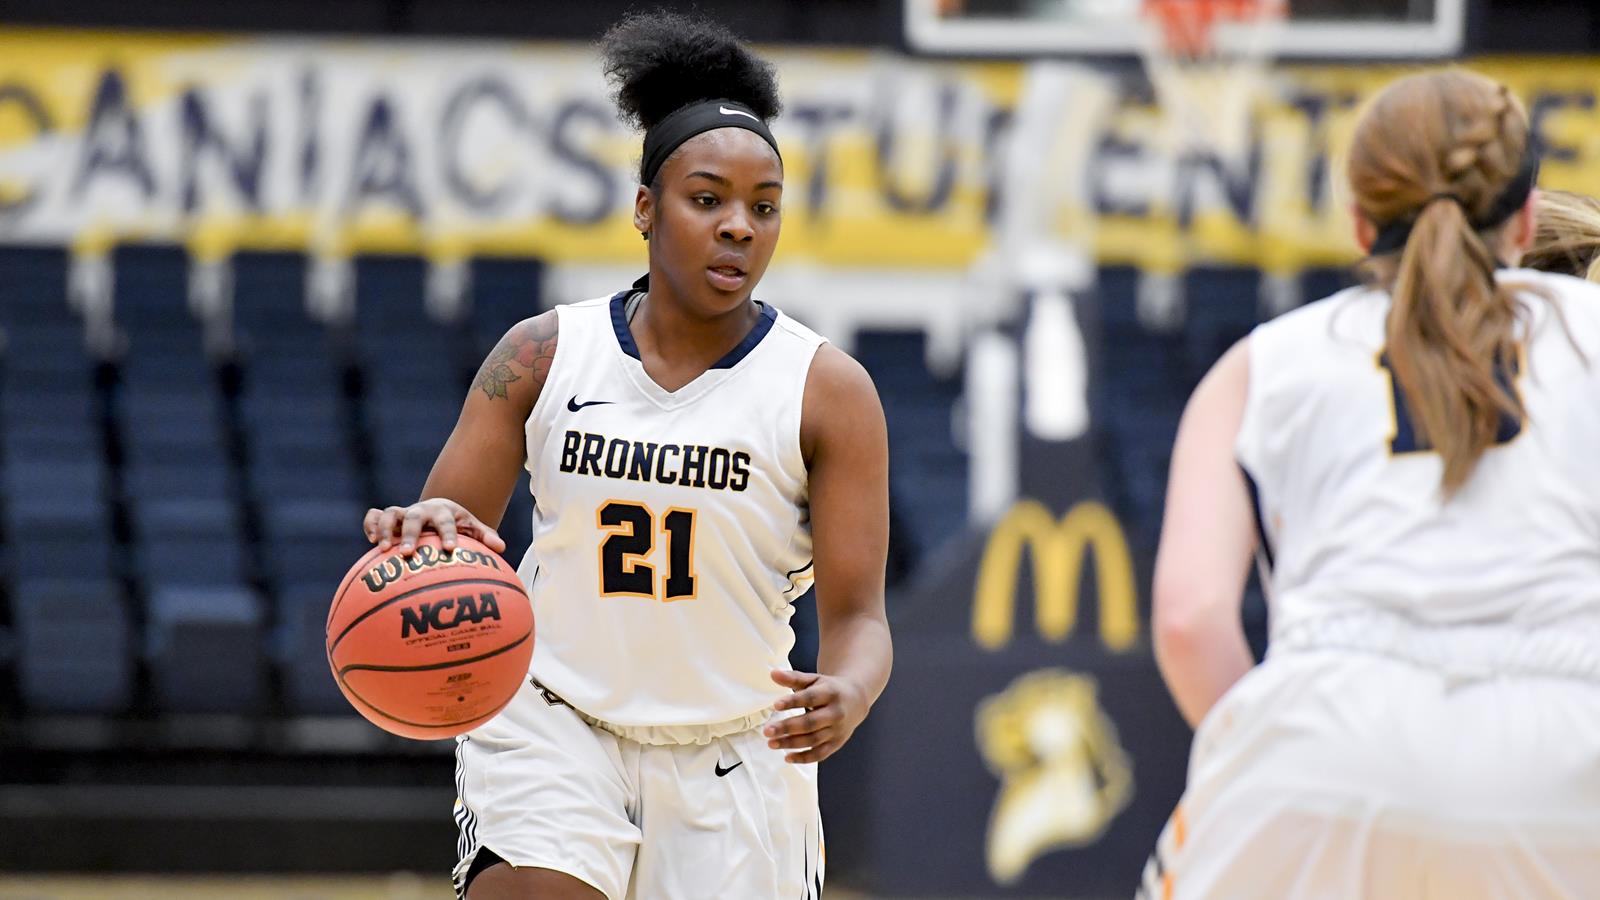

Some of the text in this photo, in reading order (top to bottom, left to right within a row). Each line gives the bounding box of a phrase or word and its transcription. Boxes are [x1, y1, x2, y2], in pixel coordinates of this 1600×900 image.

[559, 430, 751, 491] BRONCHOS
[361, 544, 500, 593] Wilson
[596, 498, 698, 602] 21
[400, 591, 501, 639] NCAA
